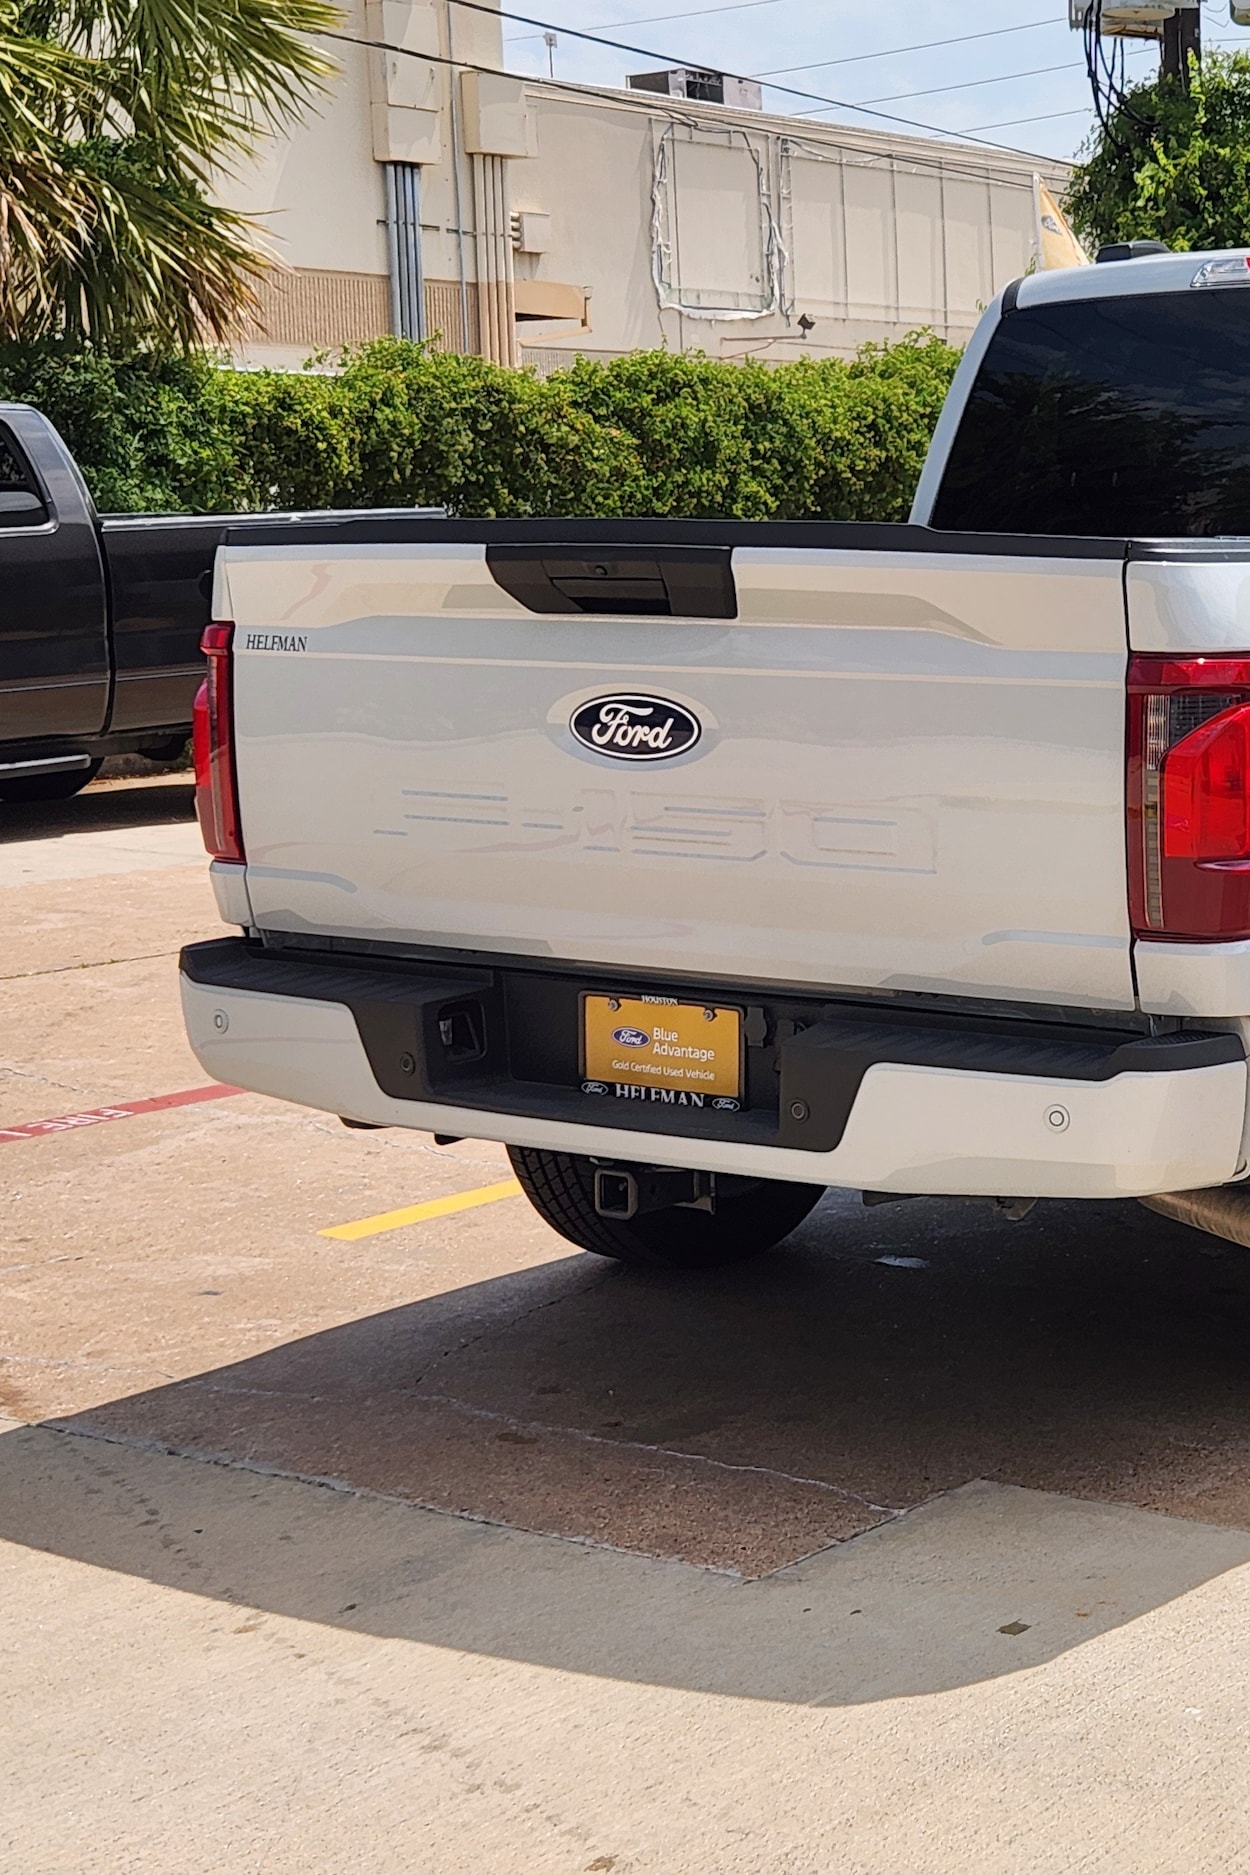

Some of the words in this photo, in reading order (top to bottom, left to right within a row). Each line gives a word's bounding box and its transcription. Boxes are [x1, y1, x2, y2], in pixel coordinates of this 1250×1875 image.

[246, 634, 308, 652] HELFMAN
[591, 703, 675, 749] Ford
[641, 995, 678, 1006] HOUSTON
[619, 1029, 644, 1045] Ford
[653, 1027, 678, 1042] Blue
[653, 1042, 715, 1062] Advantage
[612, 1060, 629, 1070] Gold
[630, 1062, 662, 1075] Certified
[663, 1066, 684, 1077] Used
[685, 1069, 715, 1080] Vehicle
